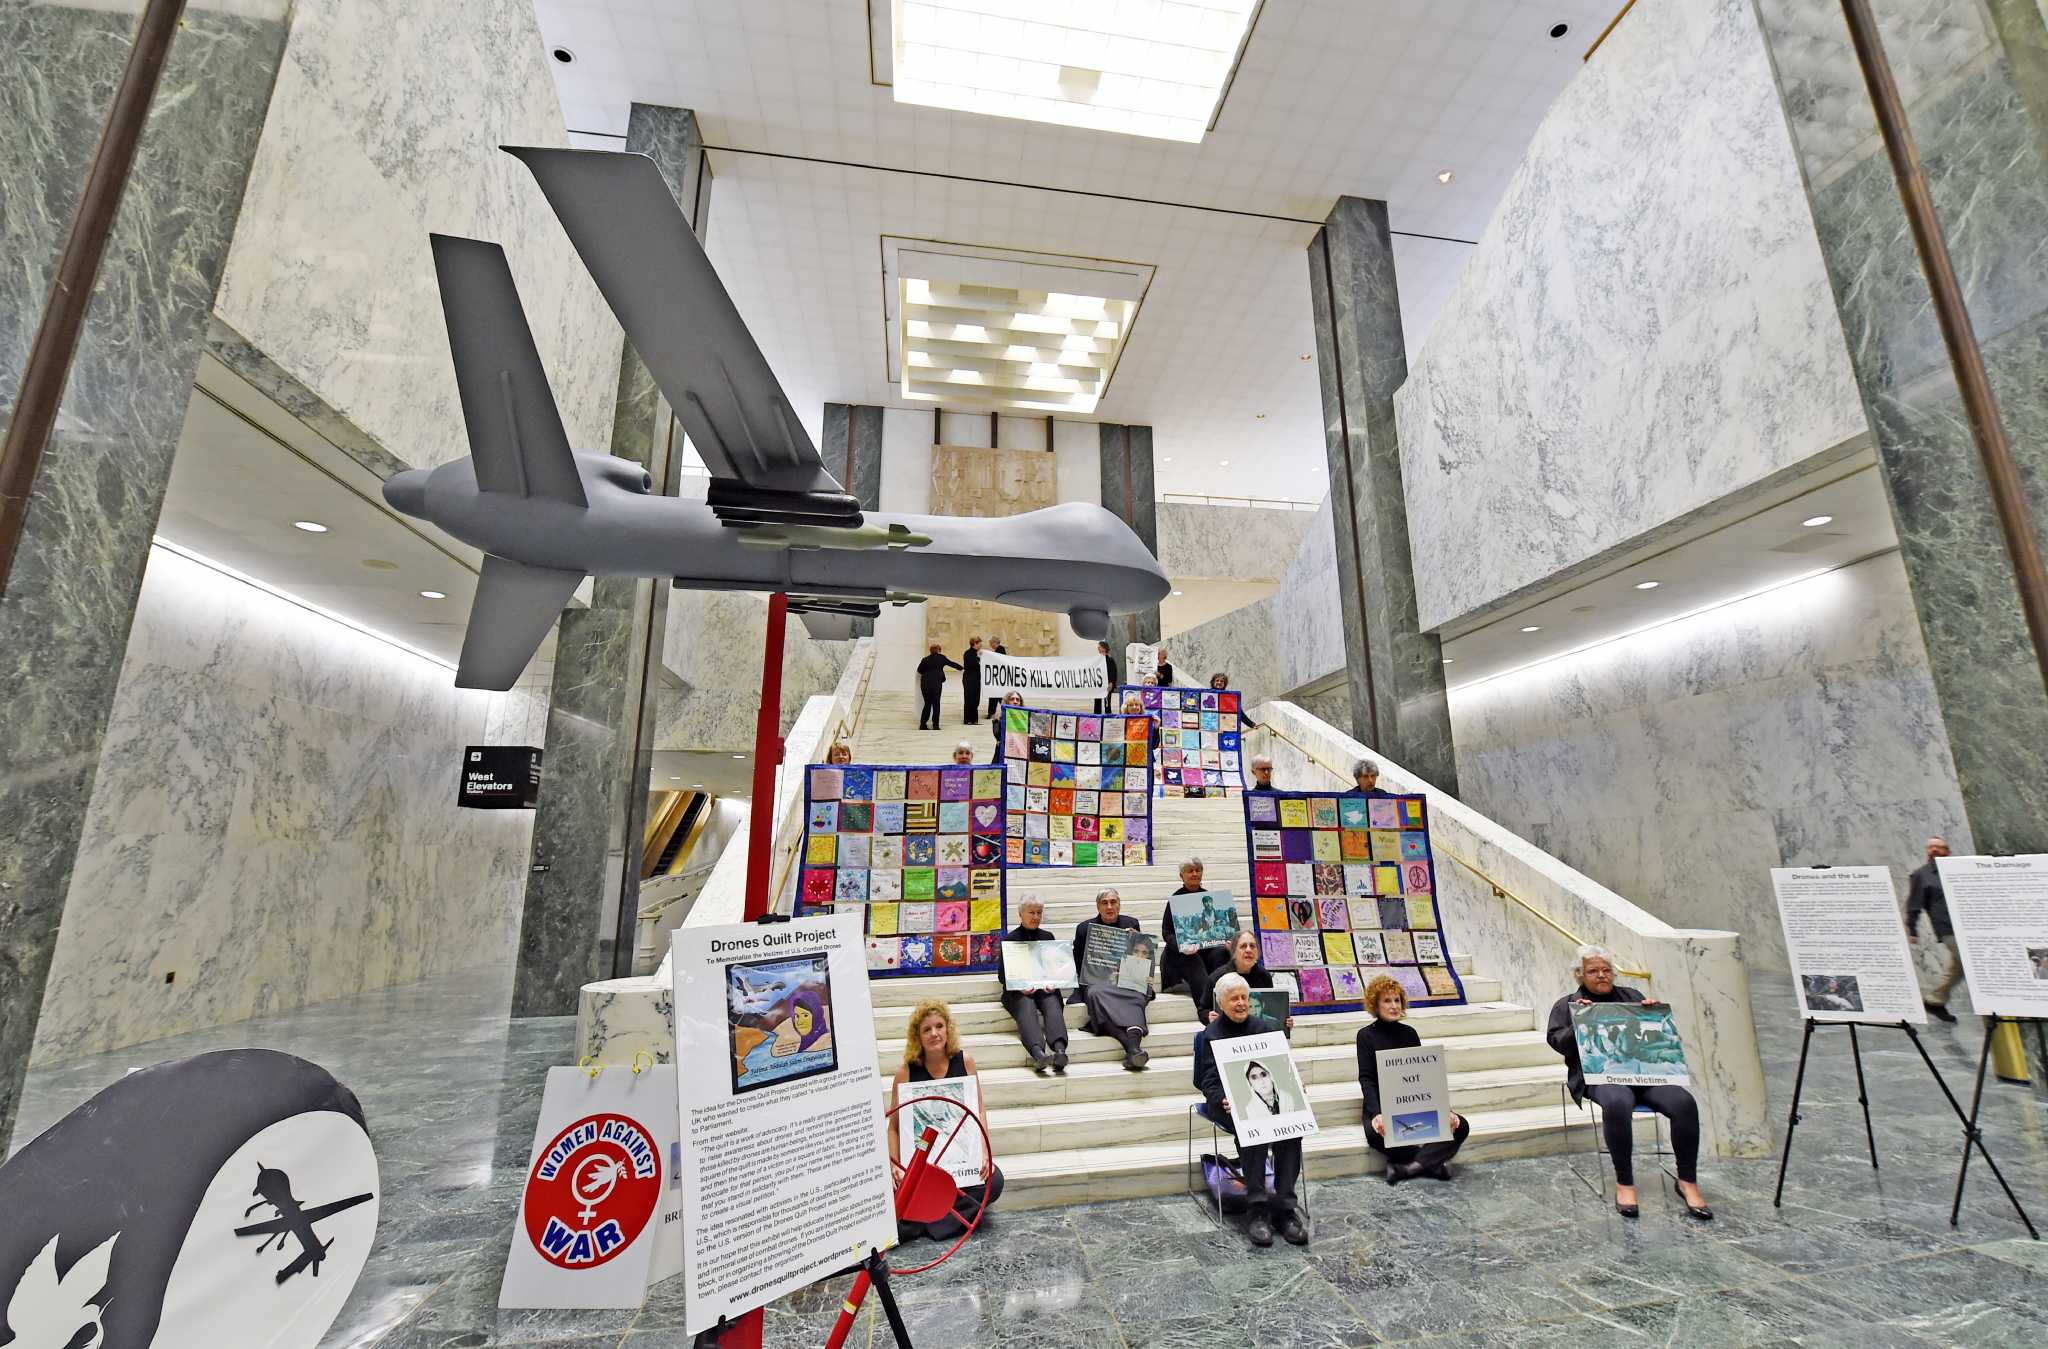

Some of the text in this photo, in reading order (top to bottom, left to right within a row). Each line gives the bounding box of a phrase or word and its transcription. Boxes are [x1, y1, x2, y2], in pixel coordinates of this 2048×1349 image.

[985, 664, 1103, 689] DRONES KILL CIVILIANS
[468, 772, 494, 781] West
[466, 781, 513, 790] Elevators
[711, 927, 836, 952] Drones Quilt Project
[1231, 1041, 1268, 1055] KILLED
[1385, 1054, 1438, 1068] DIPLOMACY
[1402, 1073, 1421, 1084] NOT
[1606, 1075, 1668, 1084] Drone Victims
[1395, 1092, 1432, 1105] DRONES
[1247, 1121, 1315, 1139] BY DRONES
[540, 1121, 653, 1178] WOMEN AGAINST
[542, 1220, 622, 1260] WAR
[729, 1240, 867, 1304] www.dronesquiltproject.wordpress.om
